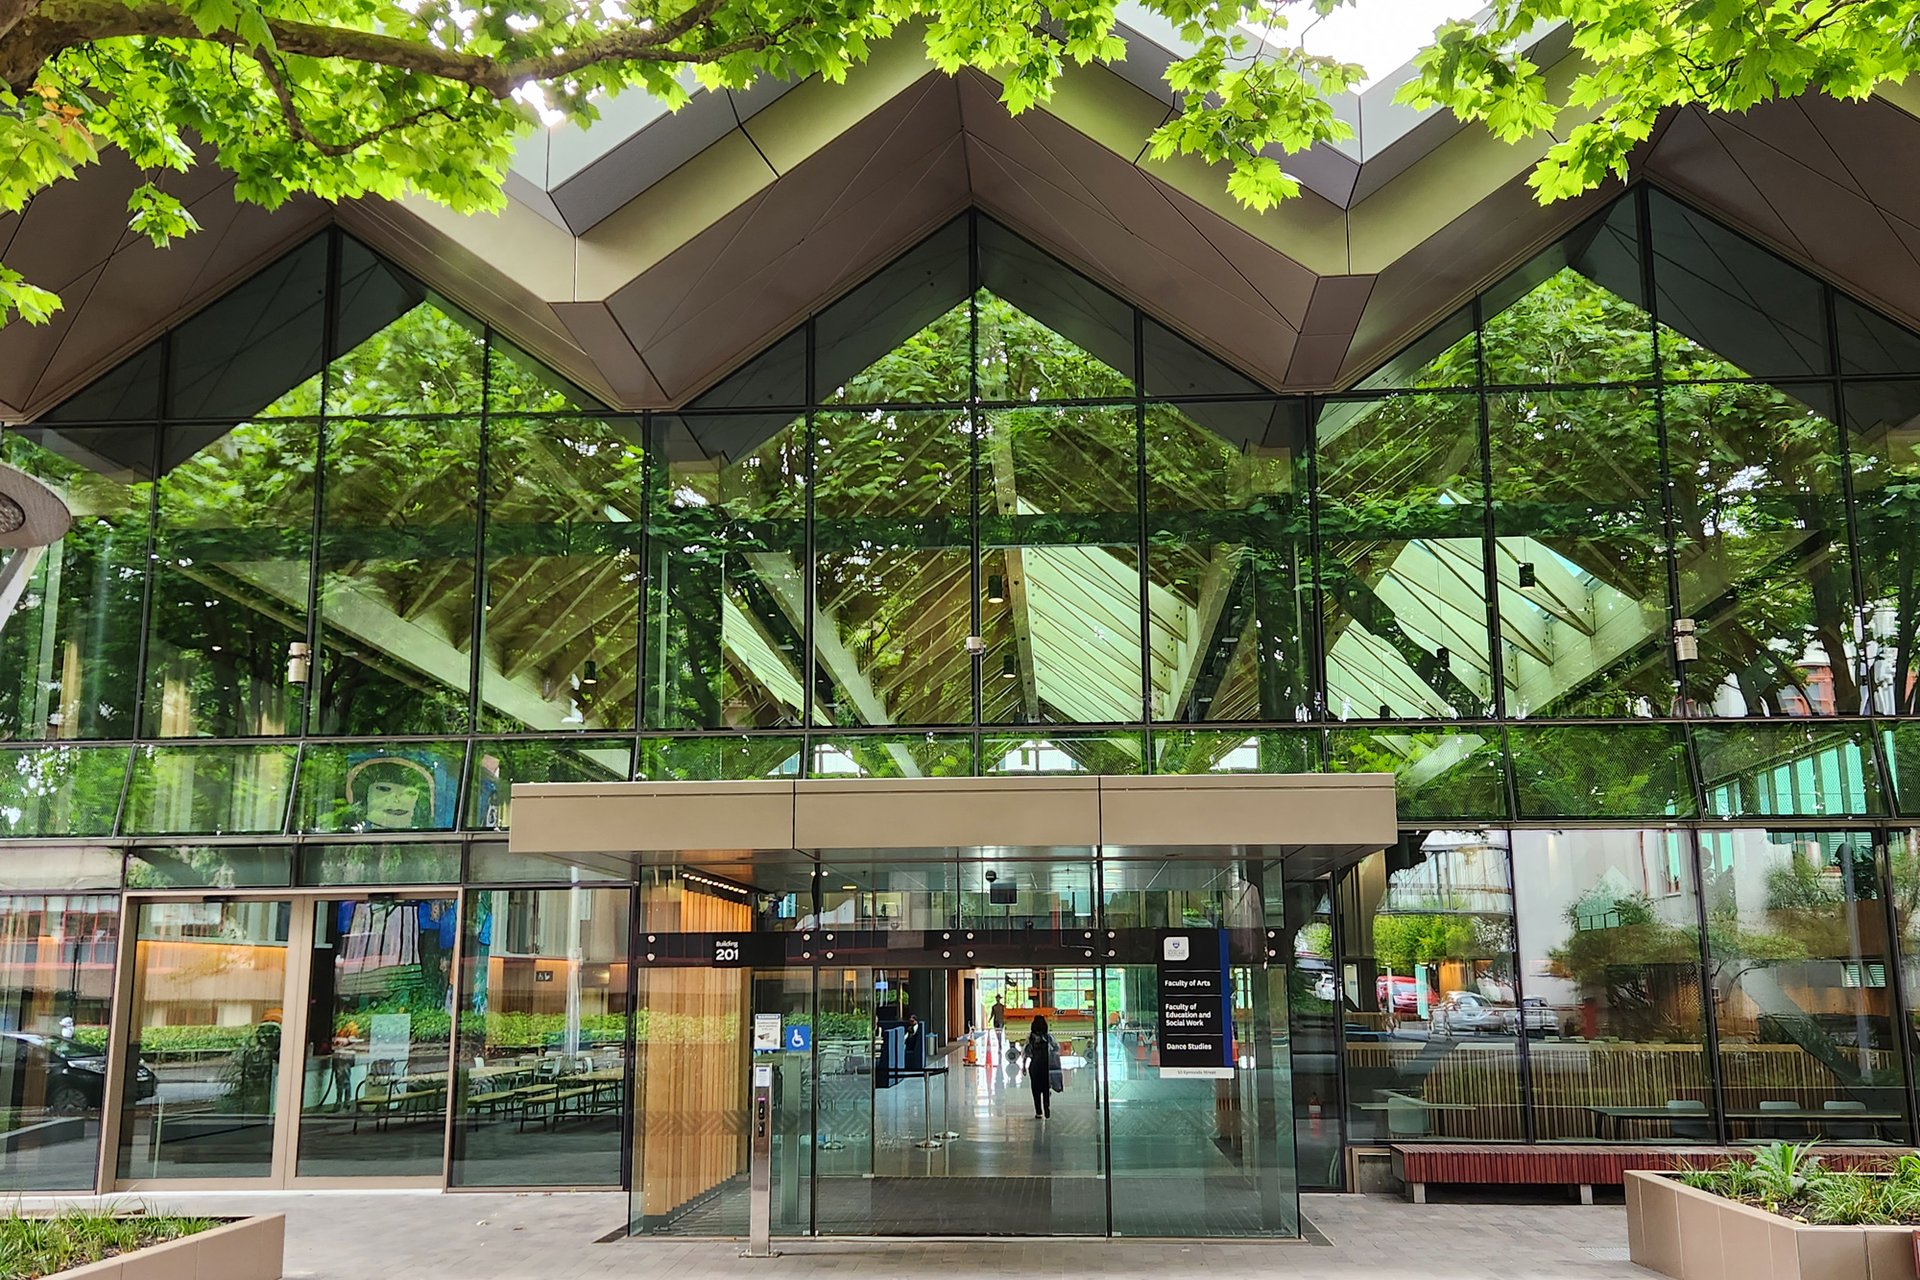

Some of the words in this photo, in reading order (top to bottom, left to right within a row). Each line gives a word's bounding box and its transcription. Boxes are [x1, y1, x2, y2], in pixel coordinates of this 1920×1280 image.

[716, 940, 738, 948] Building
[716, 949, 739, 960] 201
[1165, 980, 1188, 988] Faculty
[1165, 1003, 1189, 1011] Faculty
